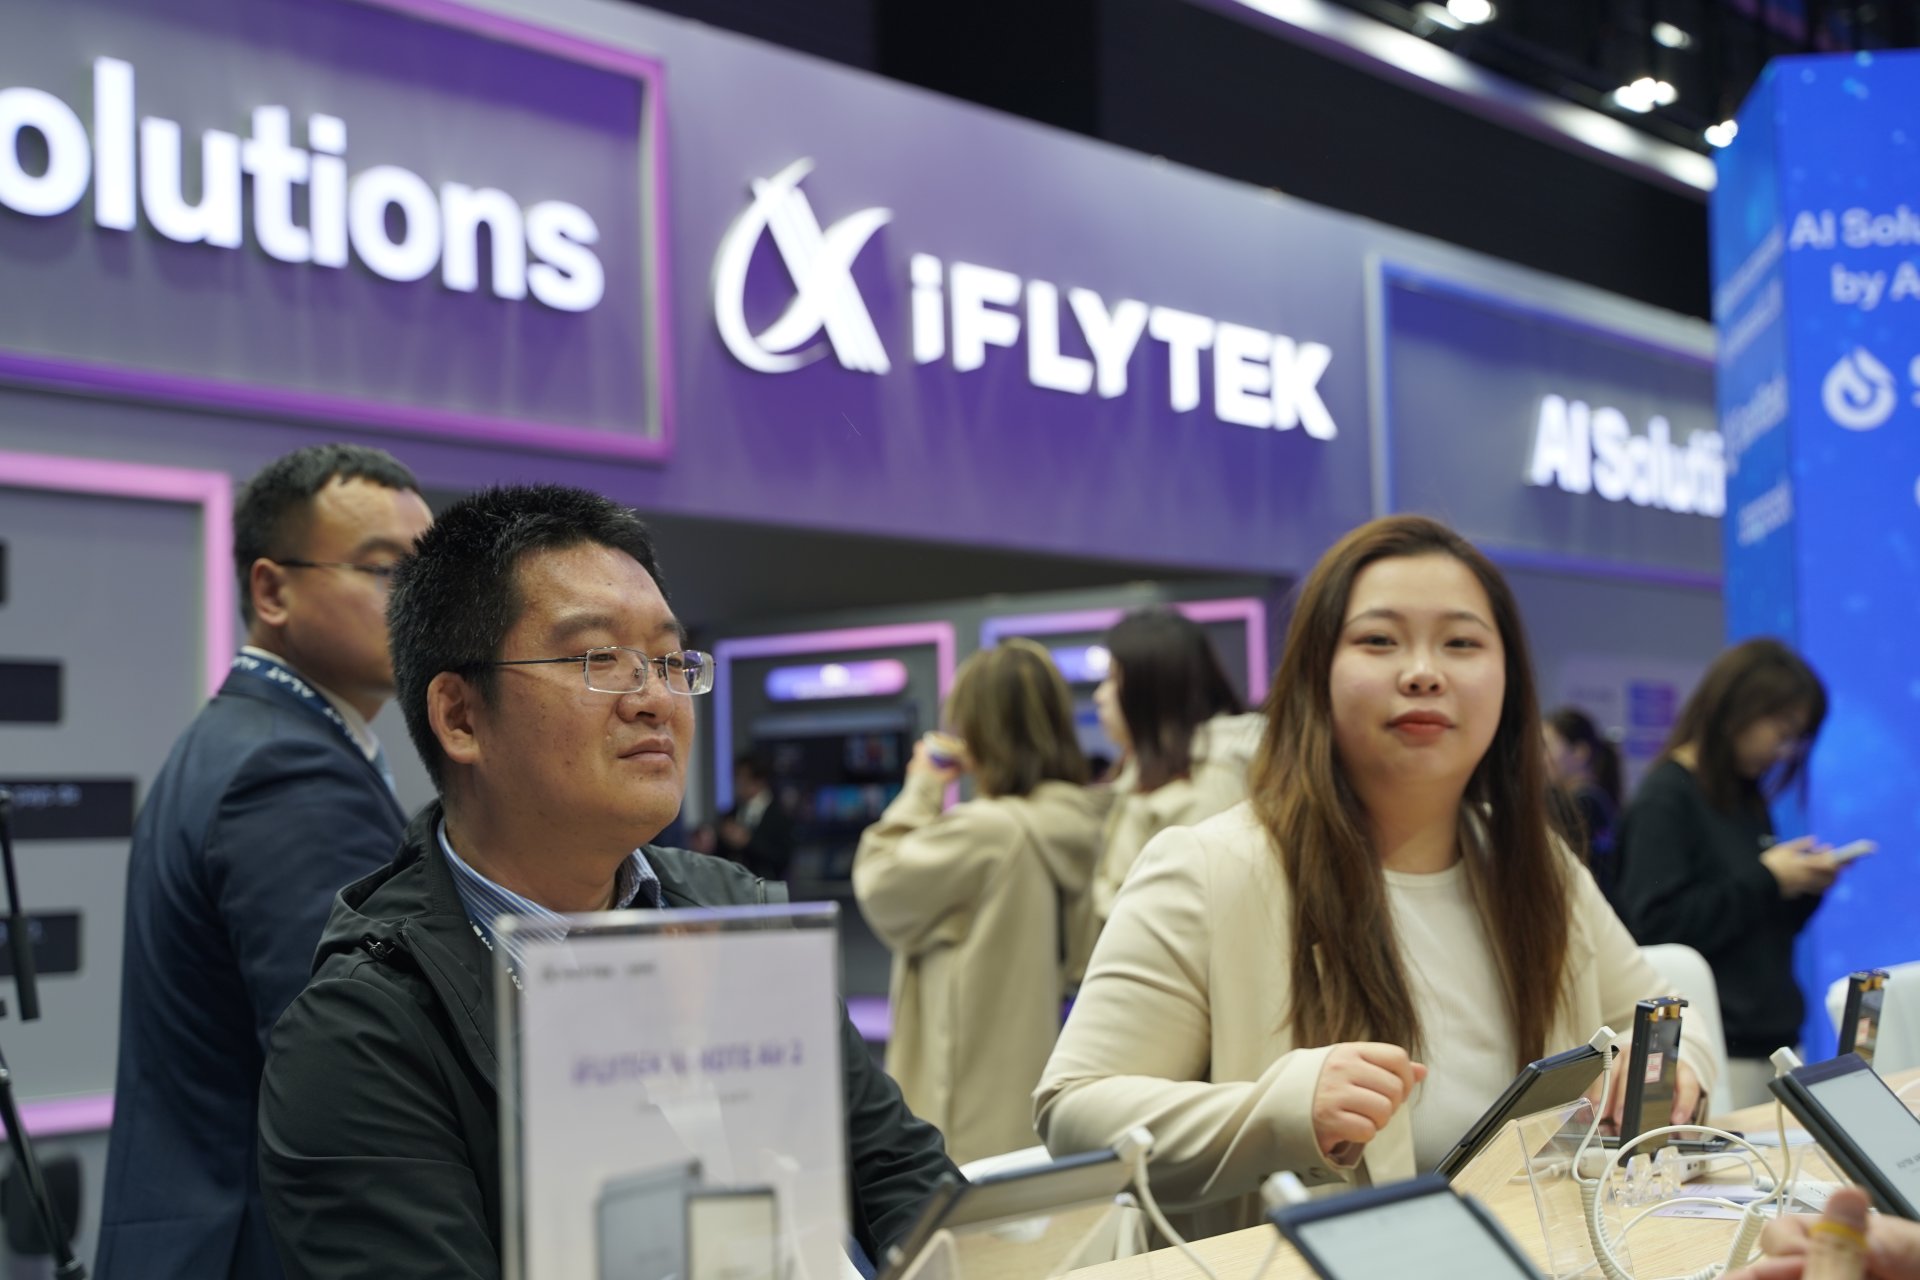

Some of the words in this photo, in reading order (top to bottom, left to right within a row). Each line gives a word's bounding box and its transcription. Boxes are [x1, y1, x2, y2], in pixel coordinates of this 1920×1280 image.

[0, 56, 604, 312] olutions
[1788, 209, 1837, 250] AI
[1831, 262, 1887, 311] by
[910, 252, 1337, 440] iFLYTEK
[1530, 394, 1592, 494] AI
